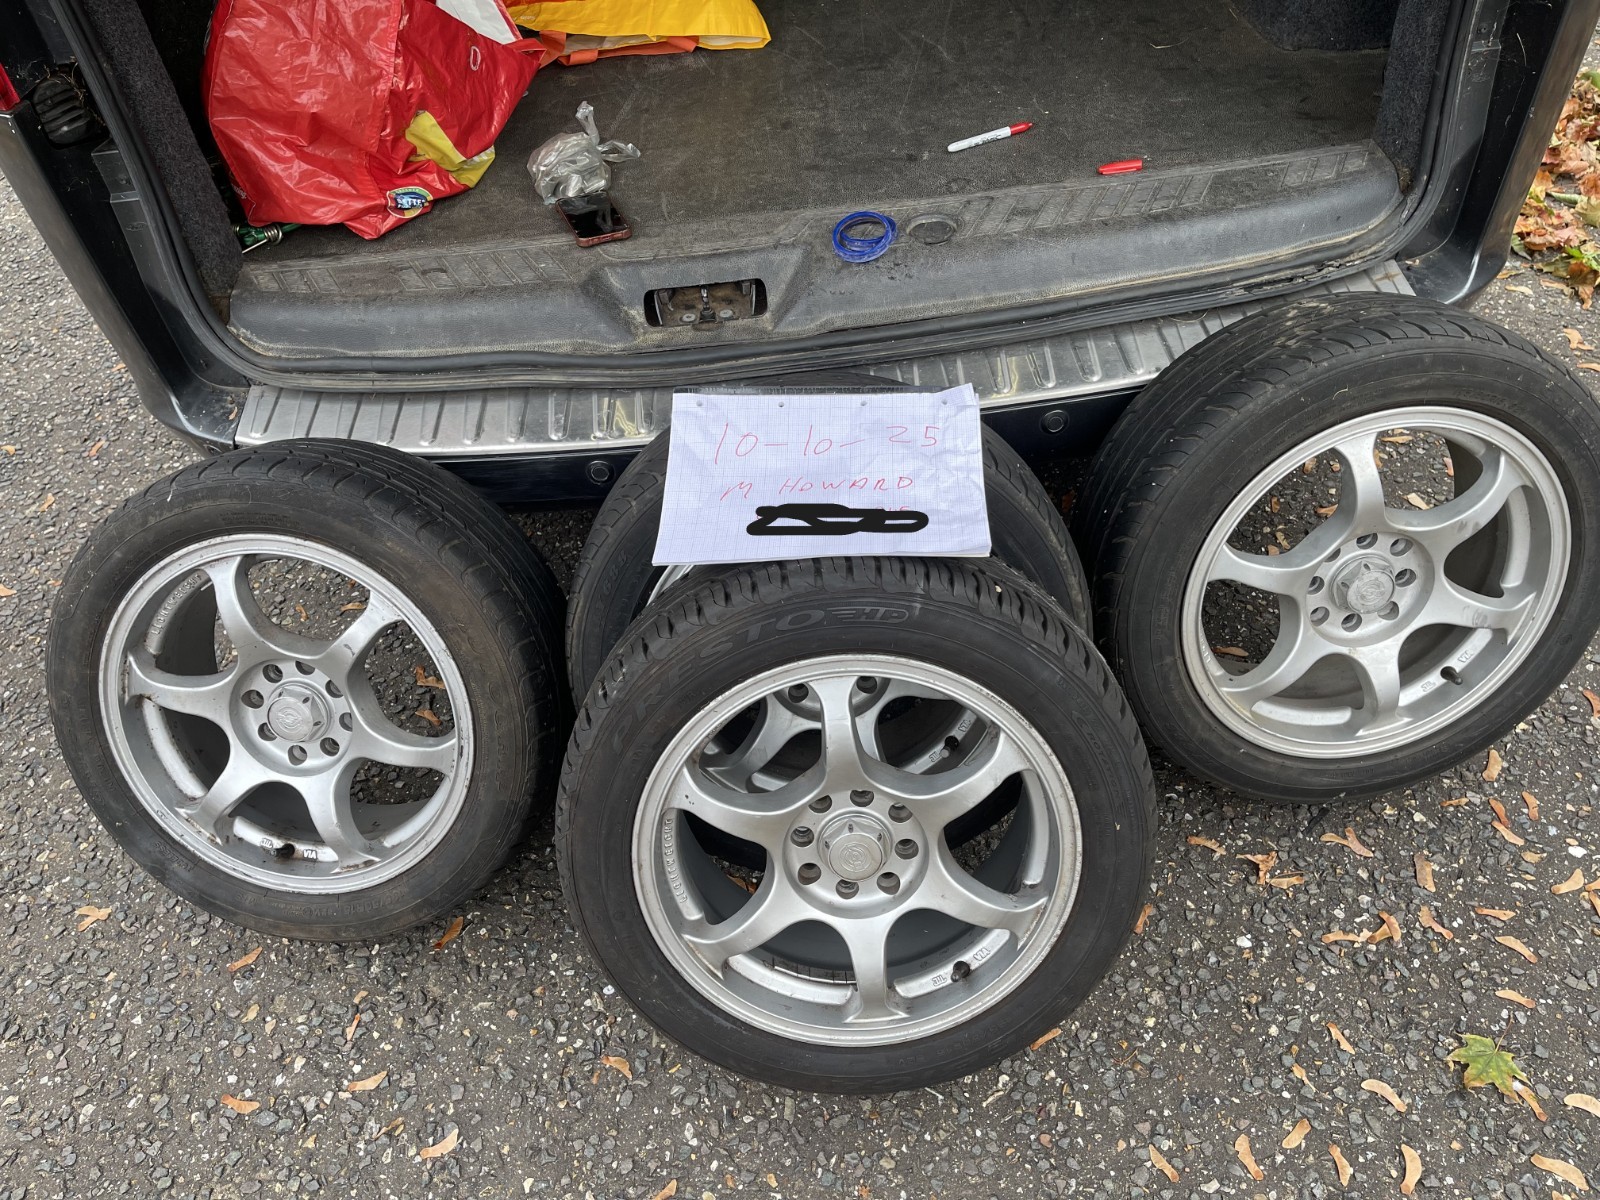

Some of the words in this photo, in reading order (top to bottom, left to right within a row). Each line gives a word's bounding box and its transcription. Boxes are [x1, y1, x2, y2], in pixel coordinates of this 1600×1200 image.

[720, 480, 753, 501] M
[778, 475, 913, 495] HOWARD
[150, 573, 202, 635] LIGHTWEIGHT
[609, 608, 827, 752] PRESTO
[302, 848, 318, 860] VIA
[663, 818, 689, 904] LIGHTWEIGHT
